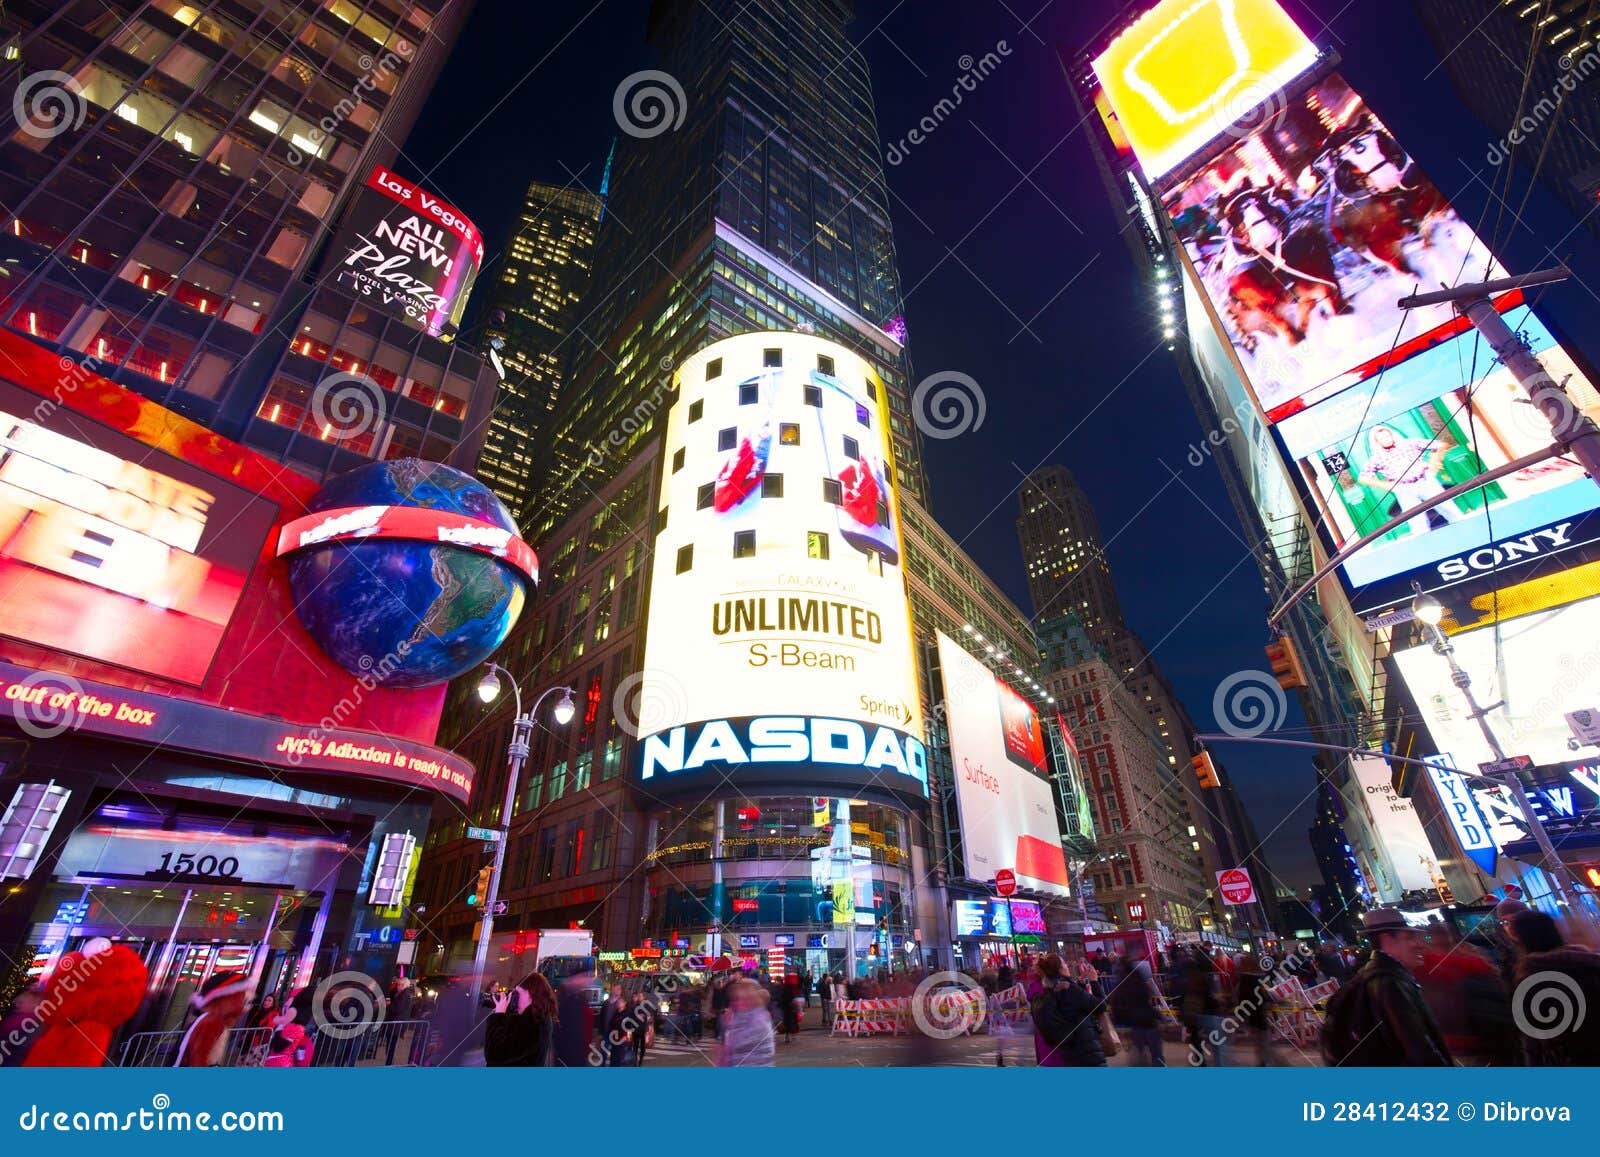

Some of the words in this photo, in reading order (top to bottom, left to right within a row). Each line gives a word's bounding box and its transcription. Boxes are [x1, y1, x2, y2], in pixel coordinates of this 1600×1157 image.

[377, 171, 412, 199] Las
[420, 193, 473, 240] Vegas
[375, 219, 454, 277] NEW!
[399, 215, 446, 251] ALL
[345, 232, 449, 315] Plaza
[352, 270, 382, 290] HOTEL
[394, 291, 430, 313] CASINO
[382, 293, 441, 333] VGAS
[1436, 522, 1572, 582] SONY
[712, 597, 882, 645] UNLIMITED
[748, 643, 855, 673] S-Beam
[5, 684, 48, 704] out
[49, 691, 79, 710] of
[77, 695, 114, 717] the
[115, 703, 156, 726] box
[860, 694, 901, 720] Sprint
[277, 736, 322, 755] JVC's
[323, 741, 391, 765] Adixxion
[393, 751, 407, 768] is
[408, 757, 441, 779] ready
[441, 763, 452, 781] to
[641, 716, 930, 799] NASDAQ
[963, 756, 1001, 795] Surface
[1386, 794, 1398, 802] to
[1390, 803, 1407, 813] the
[1431, 757, 1483, 846] NYPD
[159, 851, 239, 878] 1500
